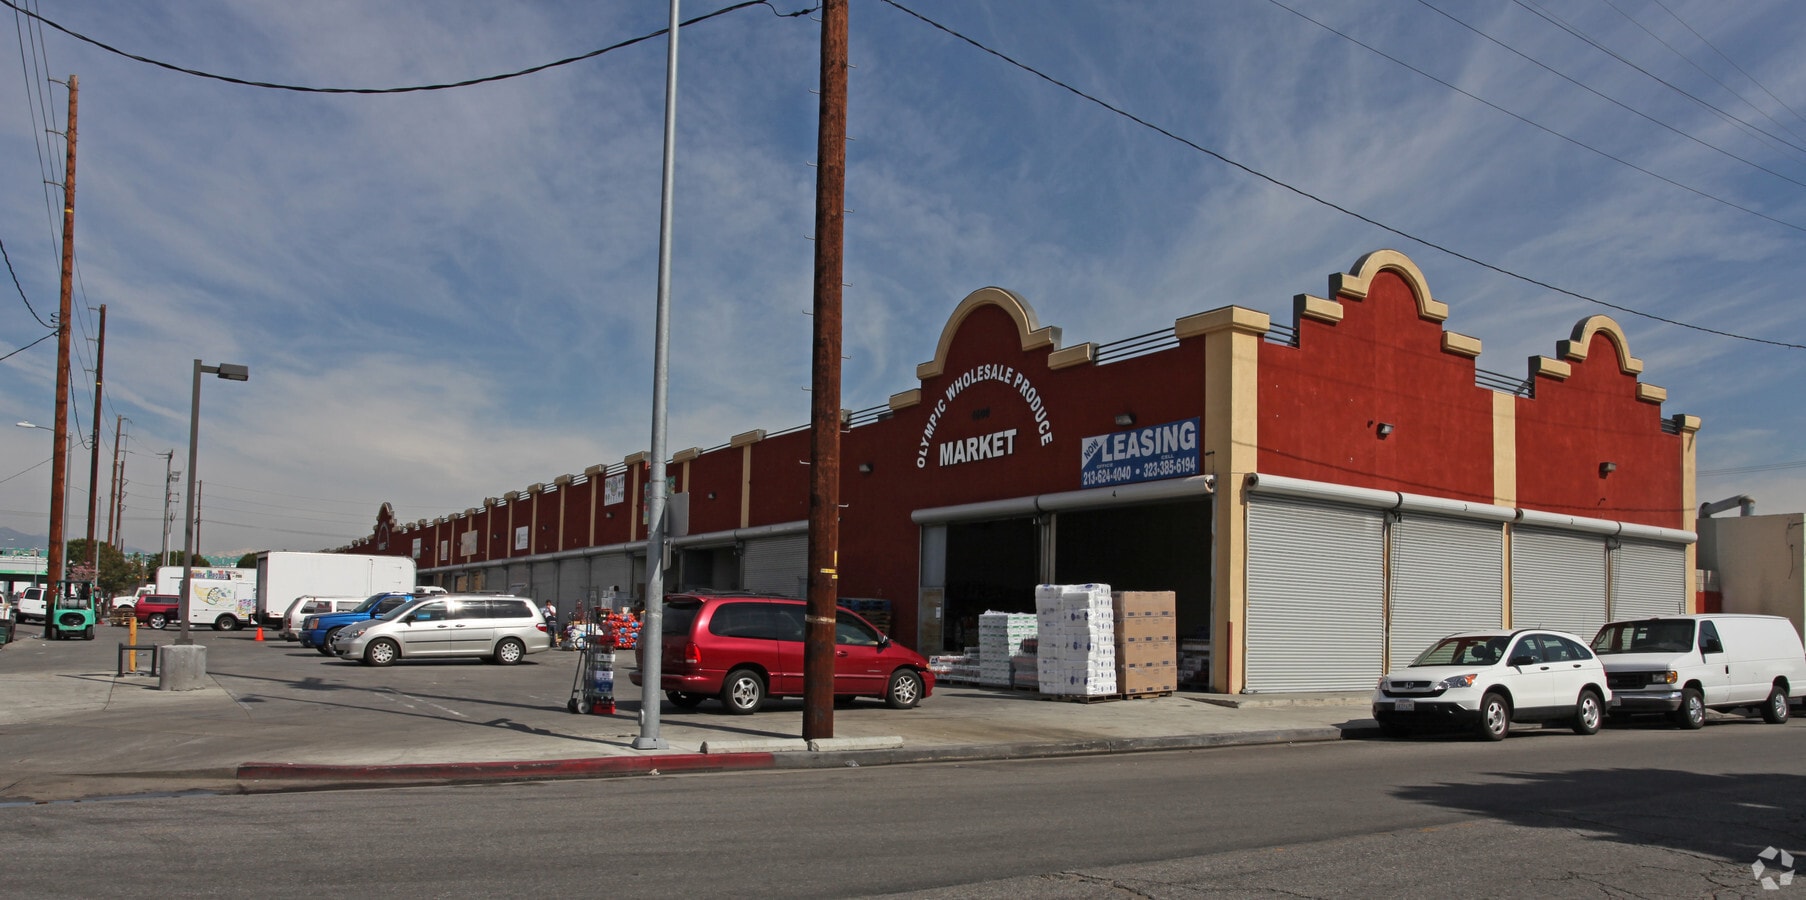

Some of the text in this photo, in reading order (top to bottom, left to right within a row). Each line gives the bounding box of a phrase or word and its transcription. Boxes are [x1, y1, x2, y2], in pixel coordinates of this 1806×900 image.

[917, 363, 1053, 468] OLYMPIC WHOLESALE PRODUCE
[939, 428, 1017, 467] MARKET
[1083, 421, 1196, 462] NOW LEASING
[1083, 456, 1196, 486] 213-624-4040 323-385-6194
